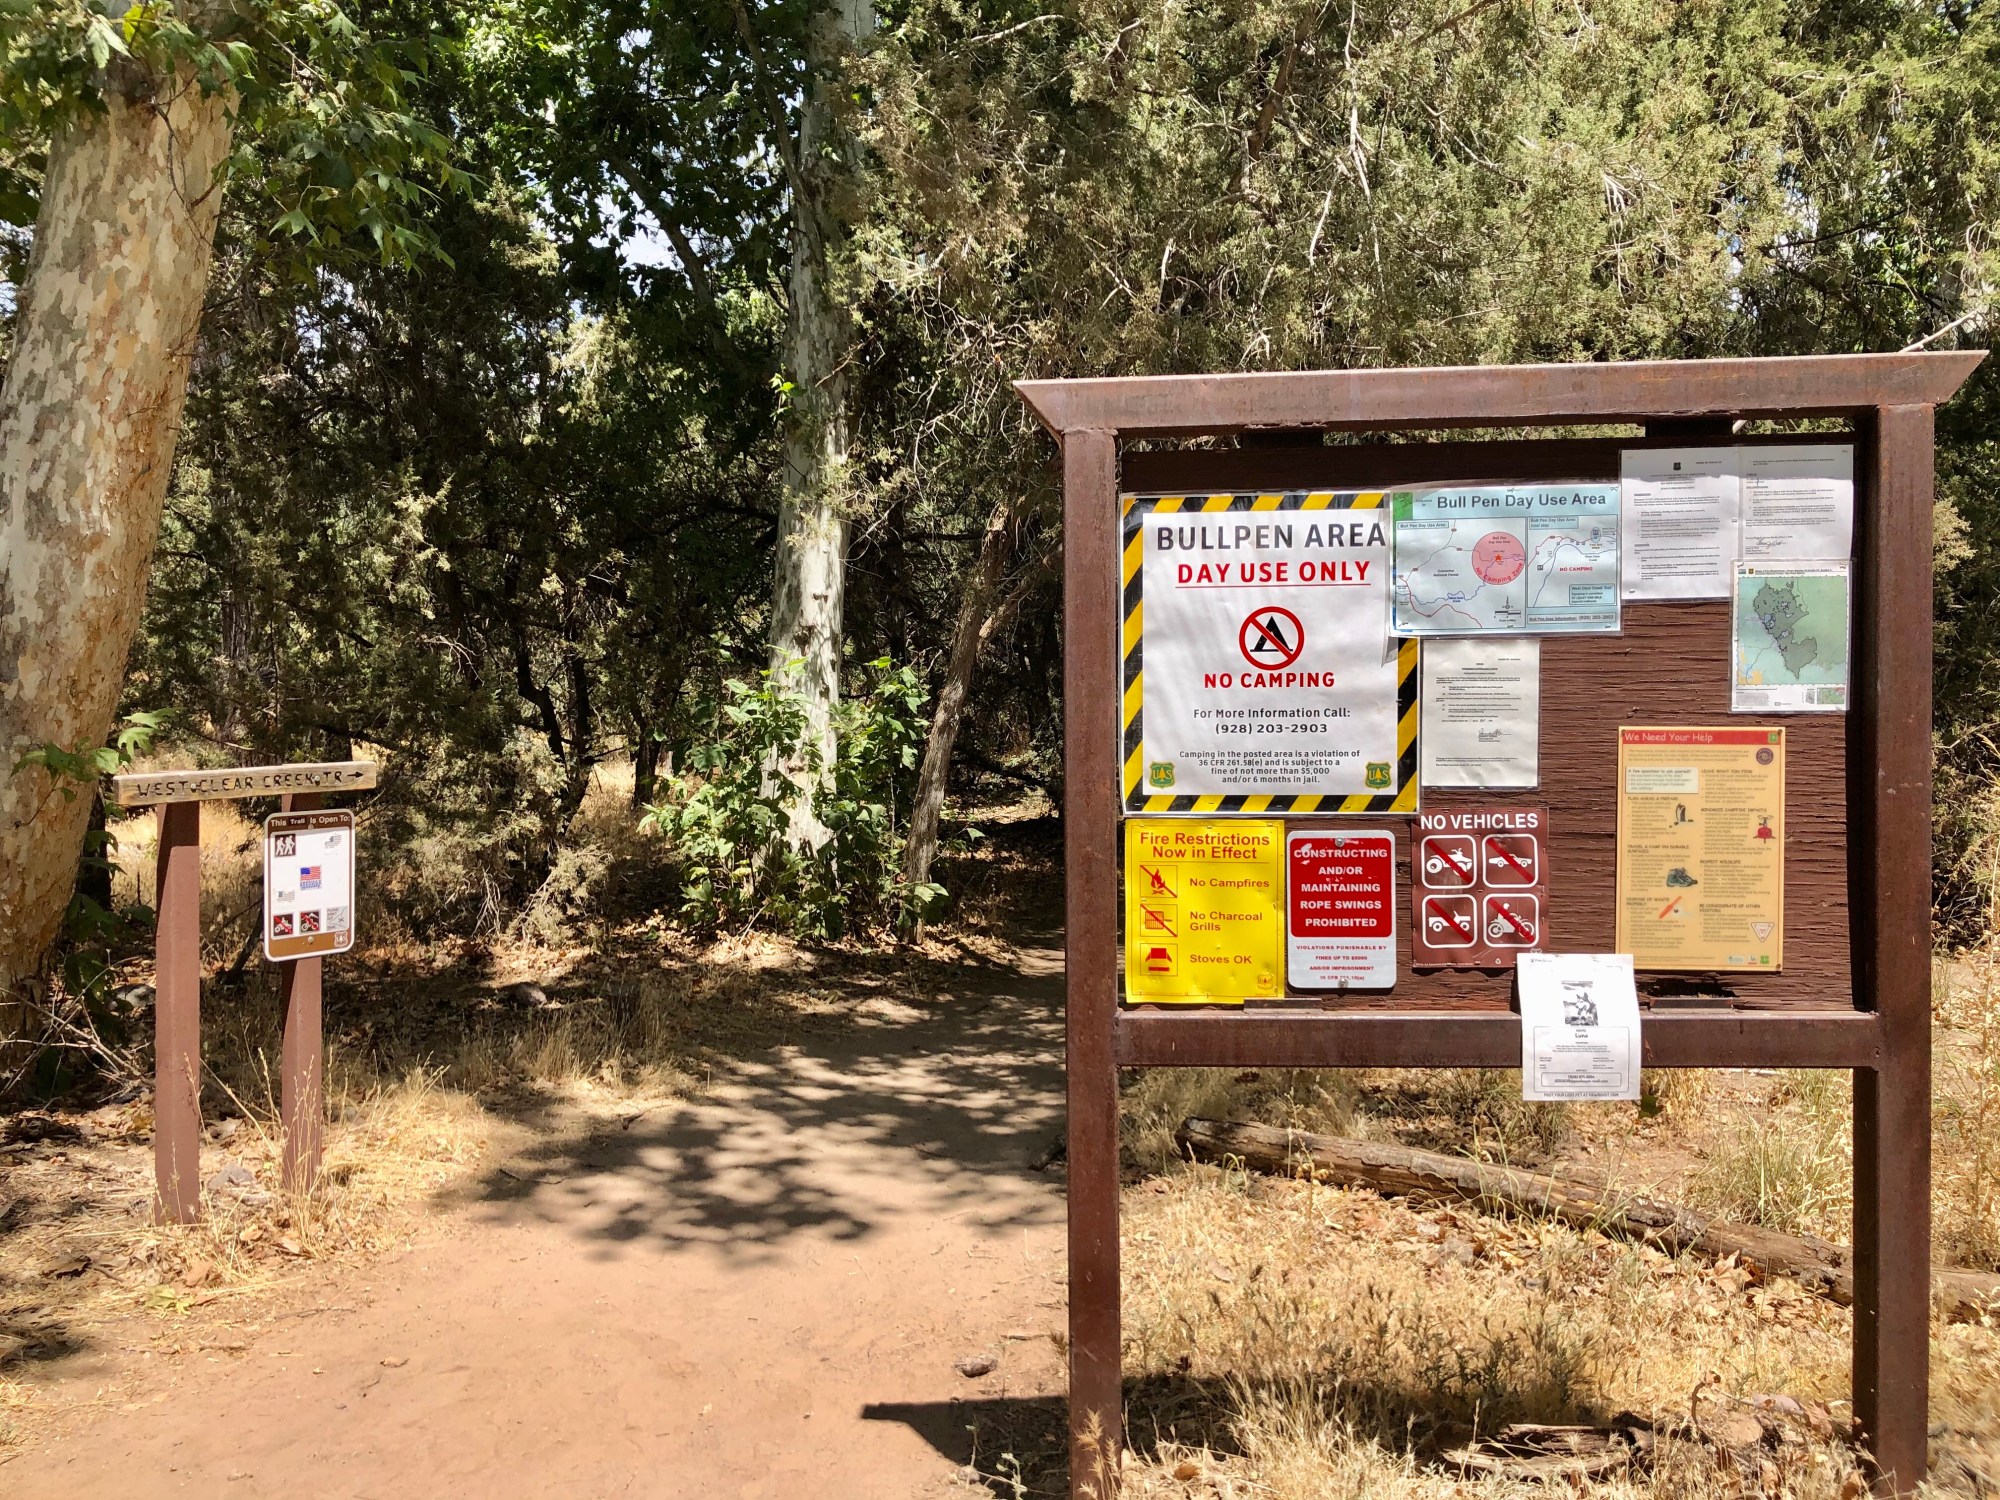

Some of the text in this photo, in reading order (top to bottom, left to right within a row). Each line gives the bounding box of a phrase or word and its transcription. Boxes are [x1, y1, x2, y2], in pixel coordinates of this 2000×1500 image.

[1437, 496, 1466, 508] Bull
[1472, 496, 1499, 507] Pen
[1505, 495, 1534, 509] Day
[1538, 494, 1567, 505] Use
[1571, 493, 1606, 505] Area
[1157, 523, 1386, 550] BULLPEN AREA
[1178, 561, 1370, 583] DAY USE ONLY
[1204, 672, 1335, 688] NO CAMPING
[1193, 707, 1350, 718] For More Information Call:
[1215, 723, 1328, 734] (928) 203-2903
[1625, 732, 1713, 743] We Need Your Help
[1180, 751, 1215, 759] Camping
[1243, 750, 1272, 758] posted
[1226, 759, 1262, 767] 261.58(e)
[1291, 759, 1322, 767] subject
[1301, 767, 1329, 775] $5,000
[137, 771, 342, 797] WEST CLEAR CREEK TR
[1303, 776, 1320, 784] jail.
[271, 819, 287, 827] This
[319, 816, 338, 825] Open
[340, 813, 350, 822] To:
[1420, 813, 1538, 830] NO VEHICLES
[1140, 832, 1270, 845] Fire Restrictions
[1153, 846, 1257, 859] Now in Effect
[1294, 849, 1387, 858] CONSTRUCTING
[1318, 867, 1363, 875] AND/OR
[1190, 878, 1270, 889] No Campfires
[1301, 884, 1380, 892] MAINTAINING
[1300, 901, 1382, 909] ROPE SWINGS
[1190, 911, 1262, 920] No Charcoal
[1190, 922, 1221, 931] Grills
[1305, 918, 1377, 927] PROHIBITED
[1190, 954, 1252, 964] Stoves OK
